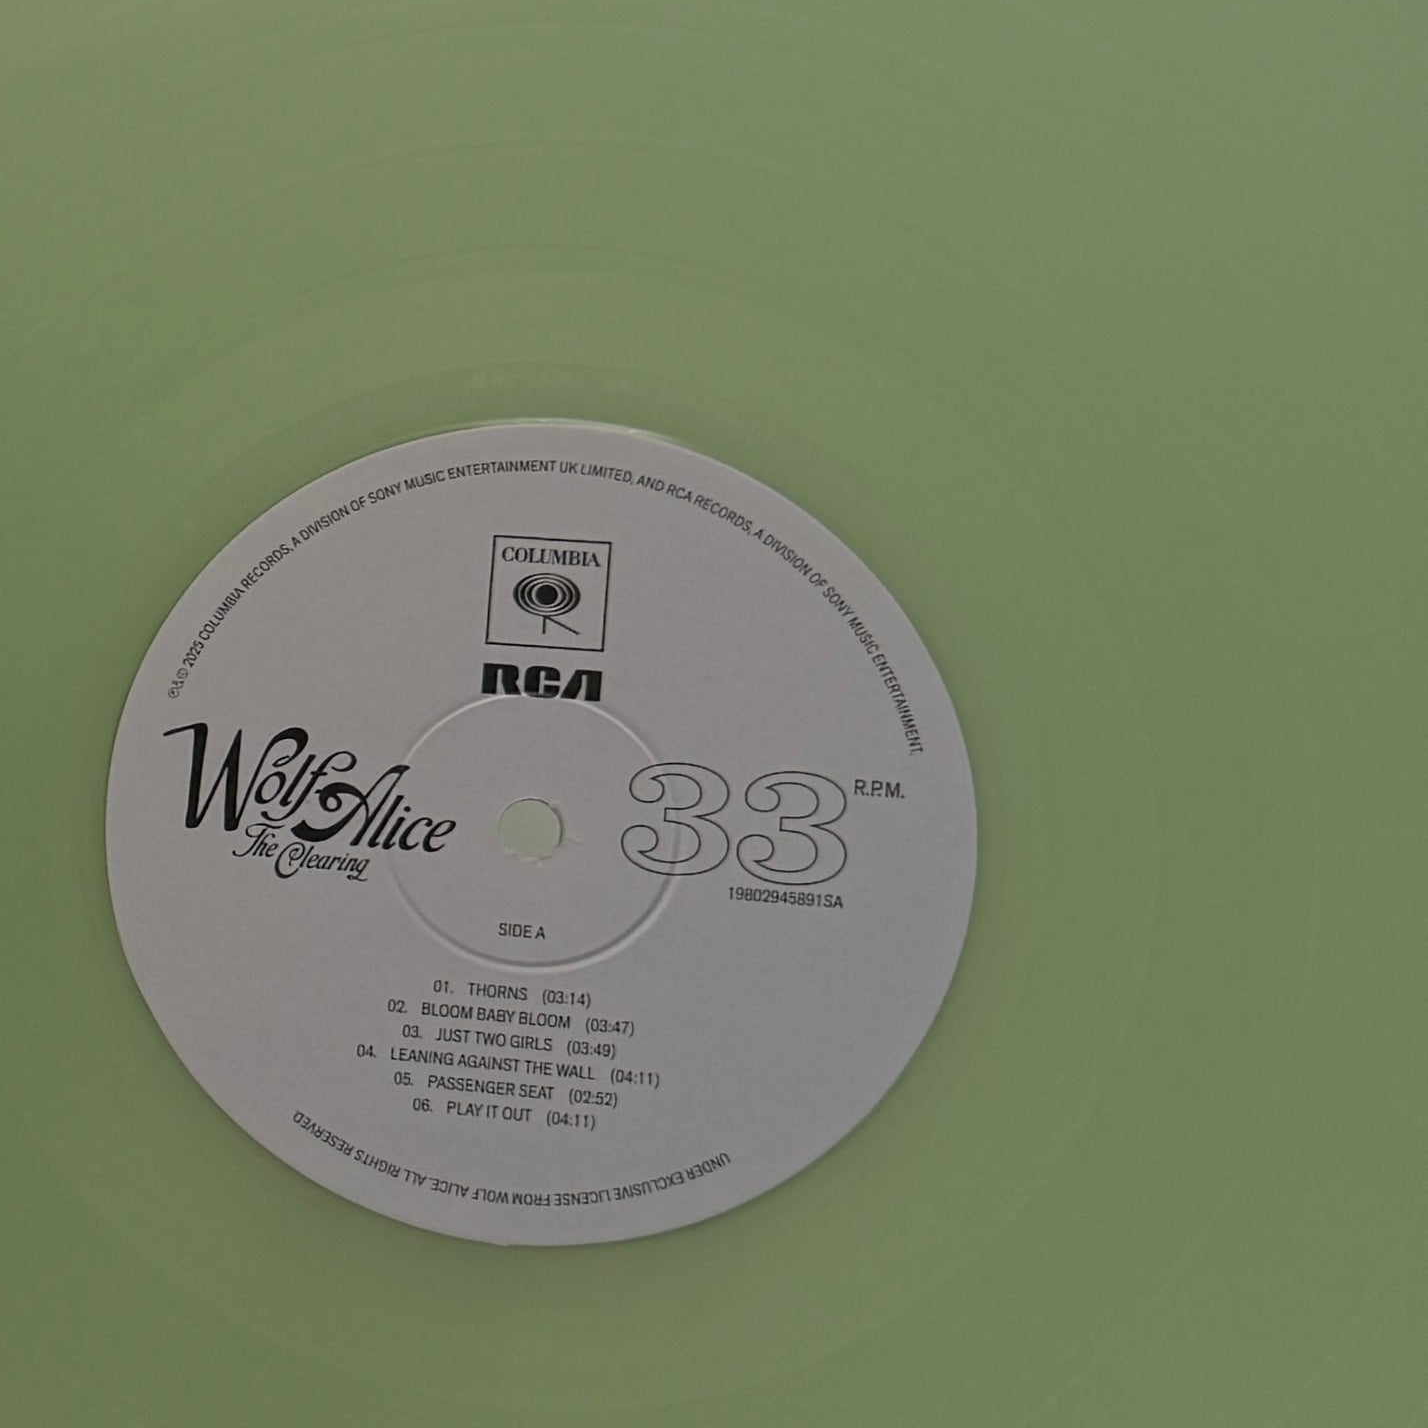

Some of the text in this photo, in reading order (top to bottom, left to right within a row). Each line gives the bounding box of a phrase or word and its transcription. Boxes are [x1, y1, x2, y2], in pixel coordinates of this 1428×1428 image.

[183, 640, 205, 668] 2025
[199, 587, 246, 641] COLUMBIA
[241, 543, 294, 590] RECORDS,
[292, 536, 302, 548] A
[299, 504, 351, 541] DIVISION
[350, 495, 367, 512] OF
[368, 482, 402, 504] SONY
[404, 470, 446, 491] MUSIC
[448, 459, 557, 480] ENTERTAINMENT
[559, 461, 579, 474] UK
[581, 463, 634, 485] LIMITED,
[636, 475, 665, 492] AND
[666, 483, 693, 503] RCA
[694, 494, 753, 535] RECORDS,
[754, 528, 764, 540] A
[763, 534, 813, 576] DIVISION
[809, 572, 828, 588] OF
[822, 586, 854, 618] SONY
[848, 617, 880, 655] MUSIC
[501, 546, 602, 568] COLUMBIA
[481, 663, 603, 702] RCA
[163, 722, 457, 853] Wolf Alice
[621, 762, 905, 886] 33 R.P.M.
[232, 823, 371, 882] The Clearing
[728, 886, 844, 909] 19802945891SA
[498, 922, 545, 940] SIDE A
[433, 979, 591, 1009] 01. THORNS (03:14)
[387, 999, 635, 1037] 02. BLOOM BABY BLOOM (03:47)
[402, 1024, 617, 1060] 03. JUST TWO GIRLS (03:49)
[356, 1044, 660, 1089] 04. LEANING AGAINST THE WALL (04:11)
[394, 1071, 618, 1108] 05. PASSENGER SEAT (02:52)
[412, 1098, 596, 1131] 06. PLAY IT OUT (04:11)
[354, 1149, 401, 1178] RIGHTS
[404, 1168, 427, 1186] ALL
[685, 1152, 732, 1181] UNDER
[472, 1188, 509, 1205] WOLF
[512, 1192, 551, 1206] FROM
[554, 1189, 611, 1206] LICENSE
[614, 1171, 685, 1201] EXCLUSIVE
